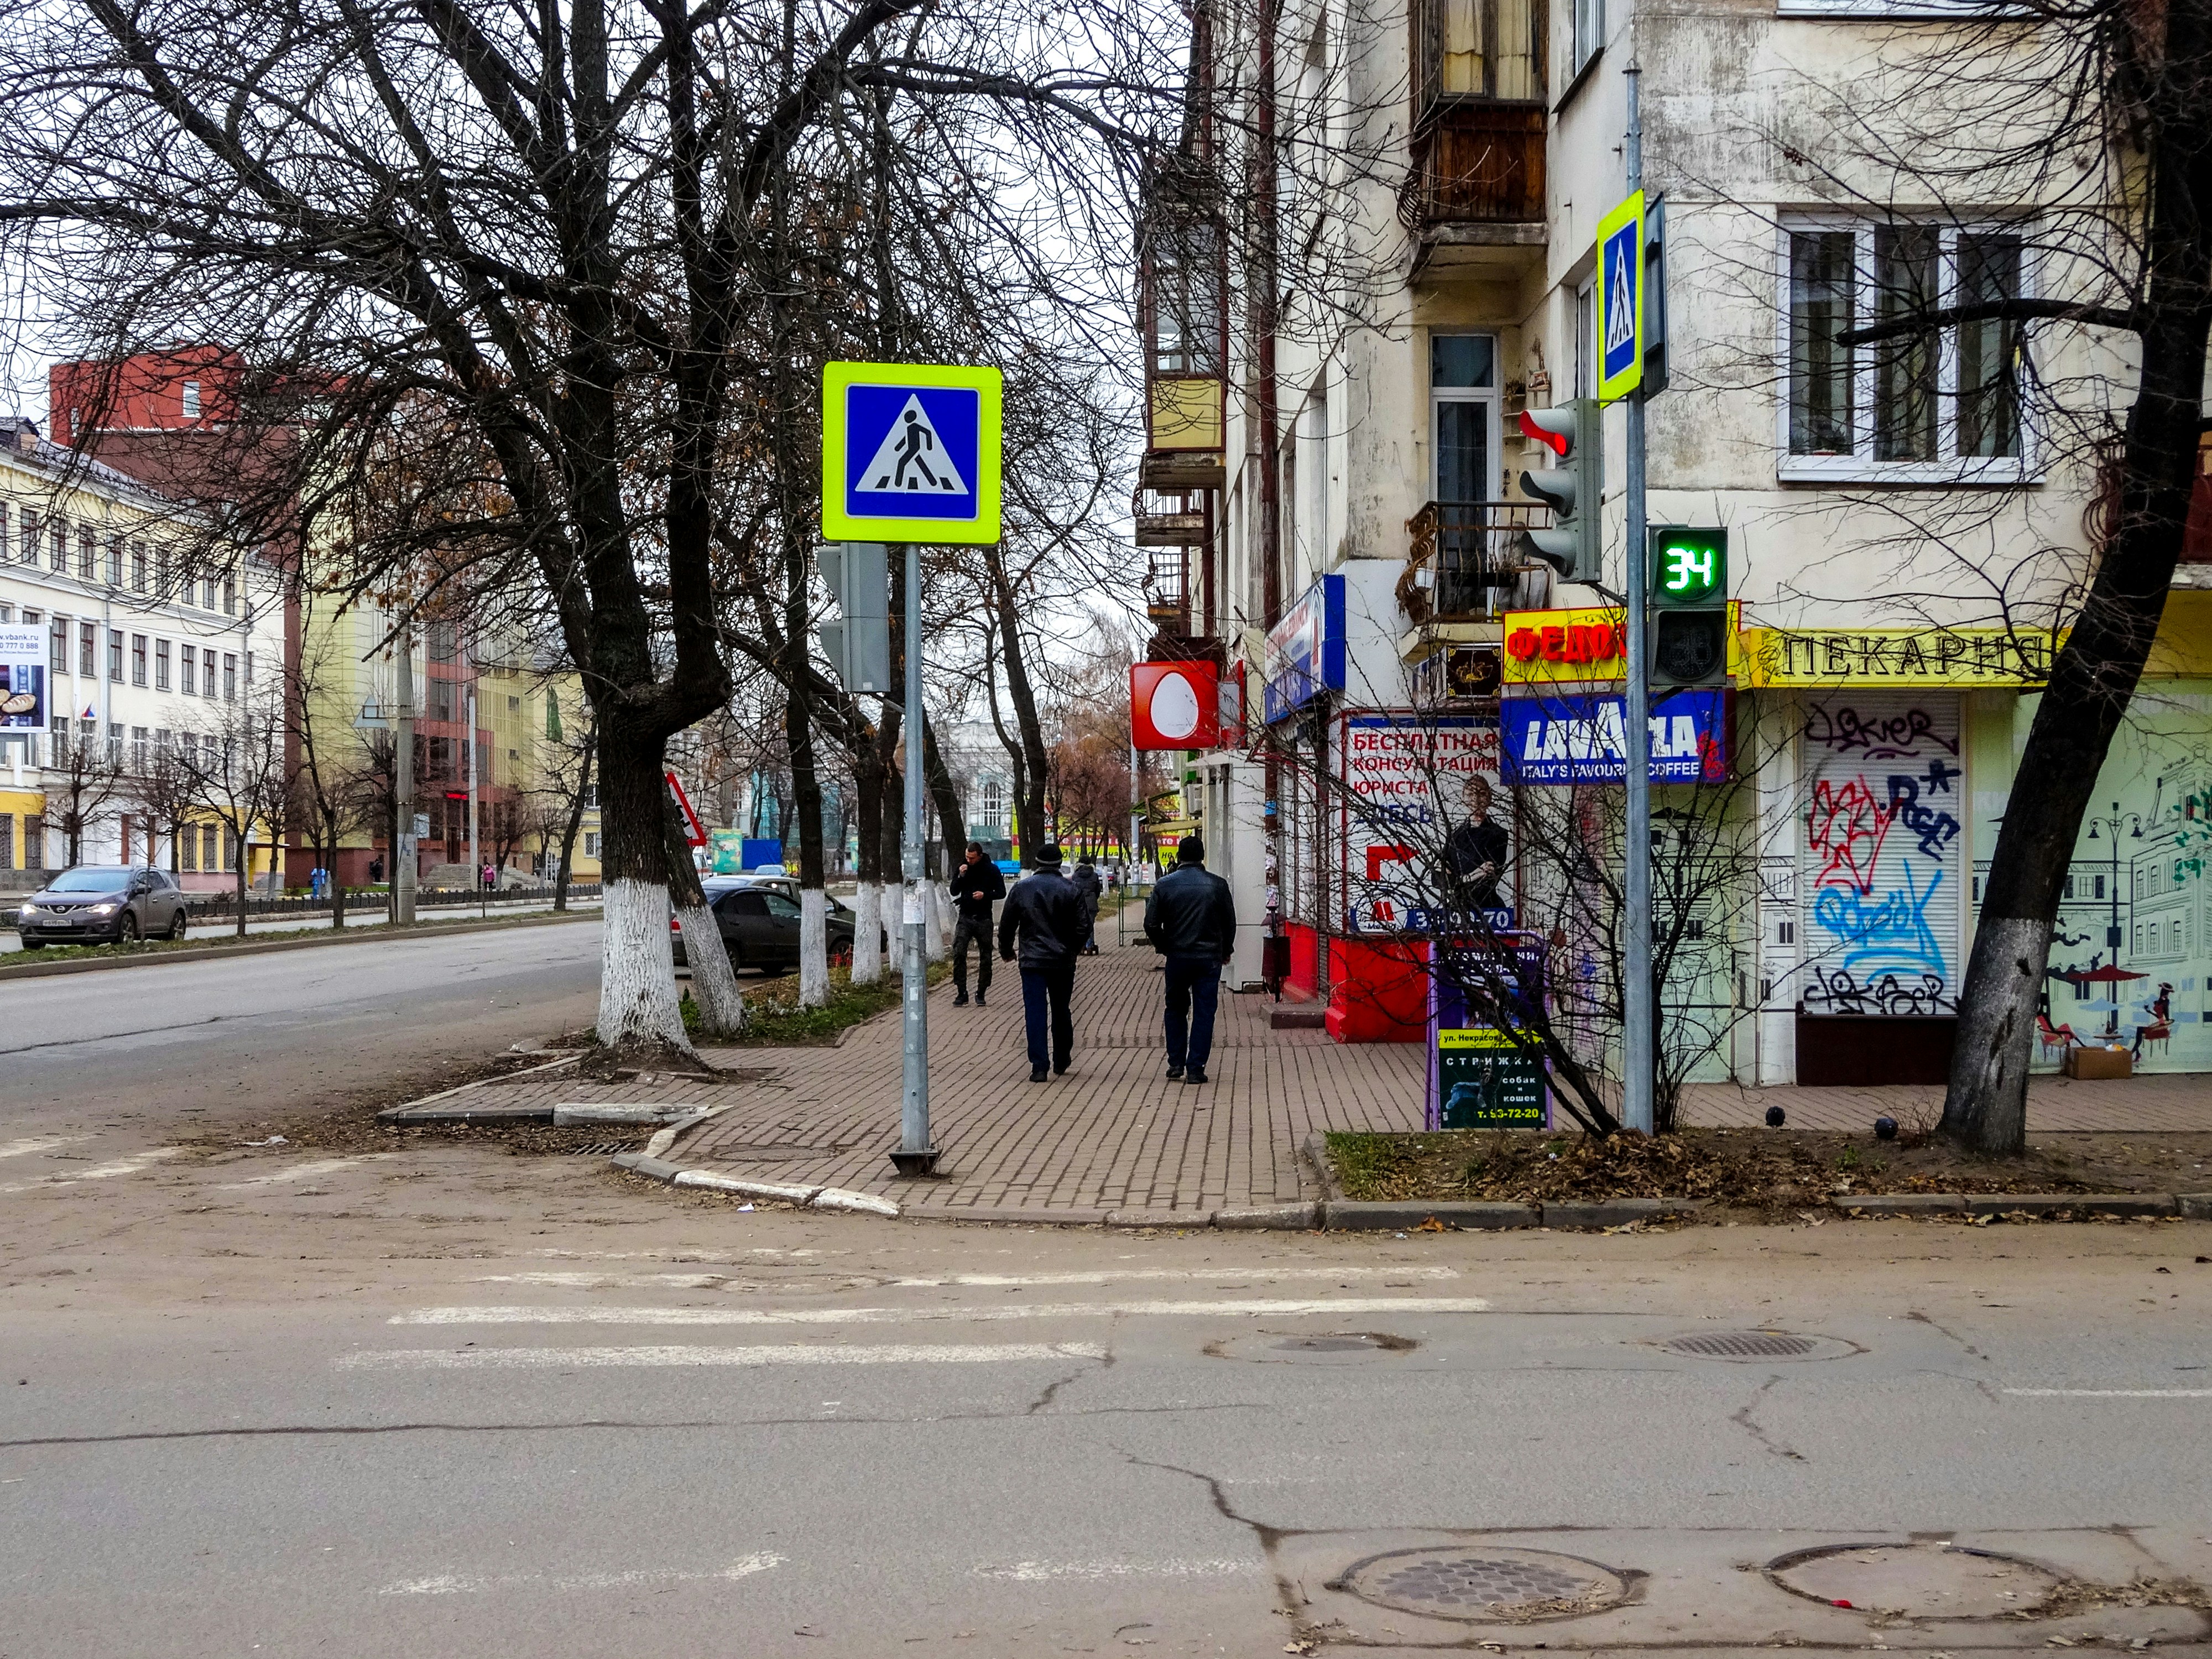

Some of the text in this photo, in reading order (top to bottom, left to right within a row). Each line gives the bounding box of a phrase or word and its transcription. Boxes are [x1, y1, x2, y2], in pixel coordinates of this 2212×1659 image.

[1666, 547, 1713, 591] 34
[1782, 635, 2044, 676] ПЕКАРНЯ
[1353, 733, 1497, 750] БЕСПЛАТНАЯ
[1522, 764, 1567, 778] ITALY'S
[1648, 761, 1699, 775] COFFEE
[1353, 780, 1428, 795] ЮРИСТА
